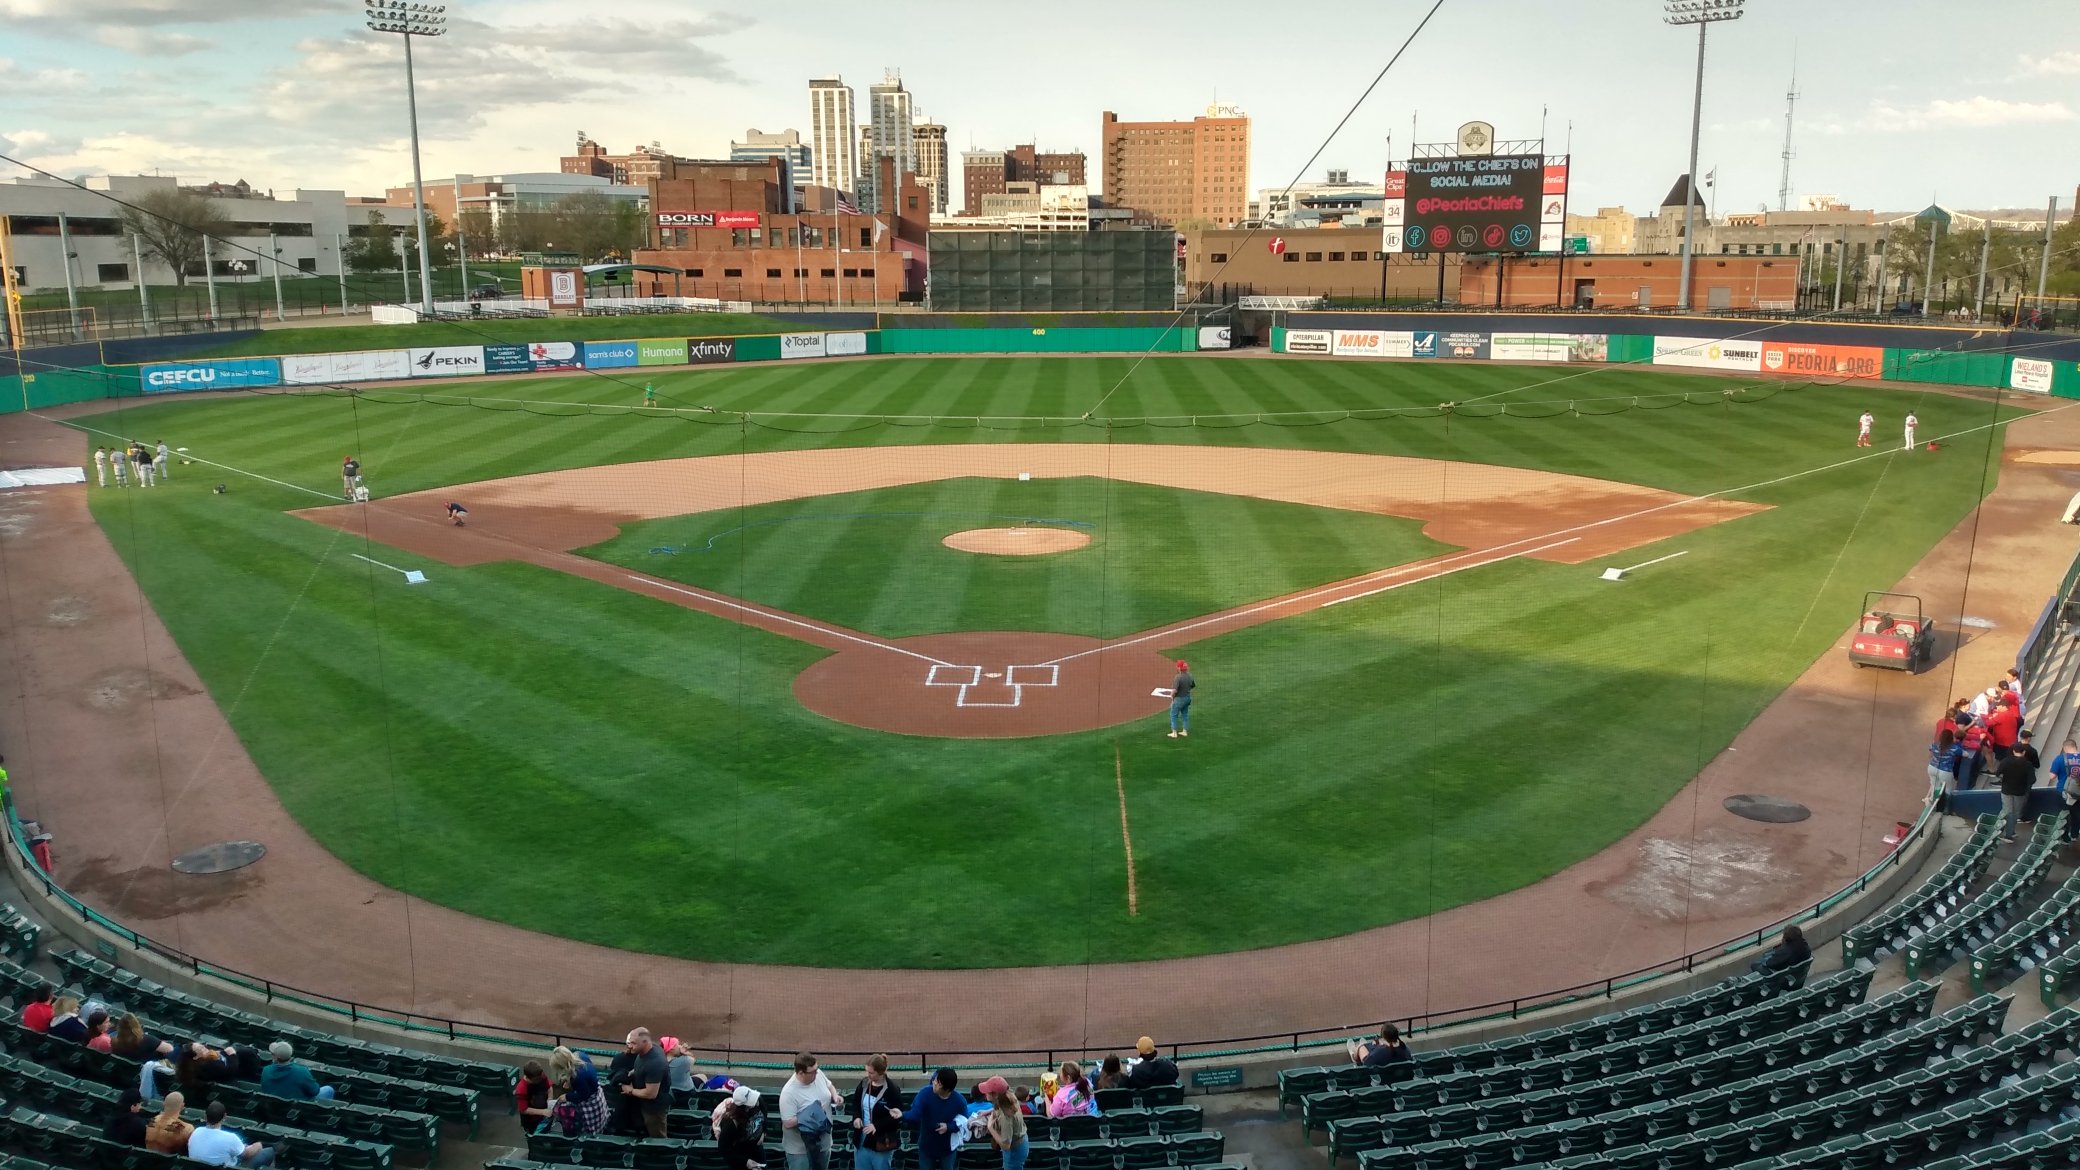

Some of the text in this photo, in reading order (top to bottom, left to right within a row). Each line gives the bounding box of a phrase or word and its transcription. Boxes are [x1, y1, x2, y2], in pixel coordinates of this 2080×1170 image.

[1218, 106, 1239, 117] PNC
[1453, 160, 1476, 172] THE
[1521, 158, 1538, 170] ON
[1430, 174, 1511, 188] SOCIAL MEDIA!
[1416, 195, 1524, 215] @PeoriaChiefs
[1388, 207, 1400, 217] 34
[659, 214, 713, 222] BORN
[791, 335, 820, 348] Toptal
[1339, 334, 1380, 347] MMS
[609, 349, 624, 358] club
[642, 347, 683, 357] Humana
[691, 341, 733, 359] xfinity
[1723, 349, 1759, 359] SUNBELT
[435, 356, 478, 366] PEKIN
[2017, 361, 2048, 372] WIELAND'S
[148, 368, 216, 386] CEFCU
